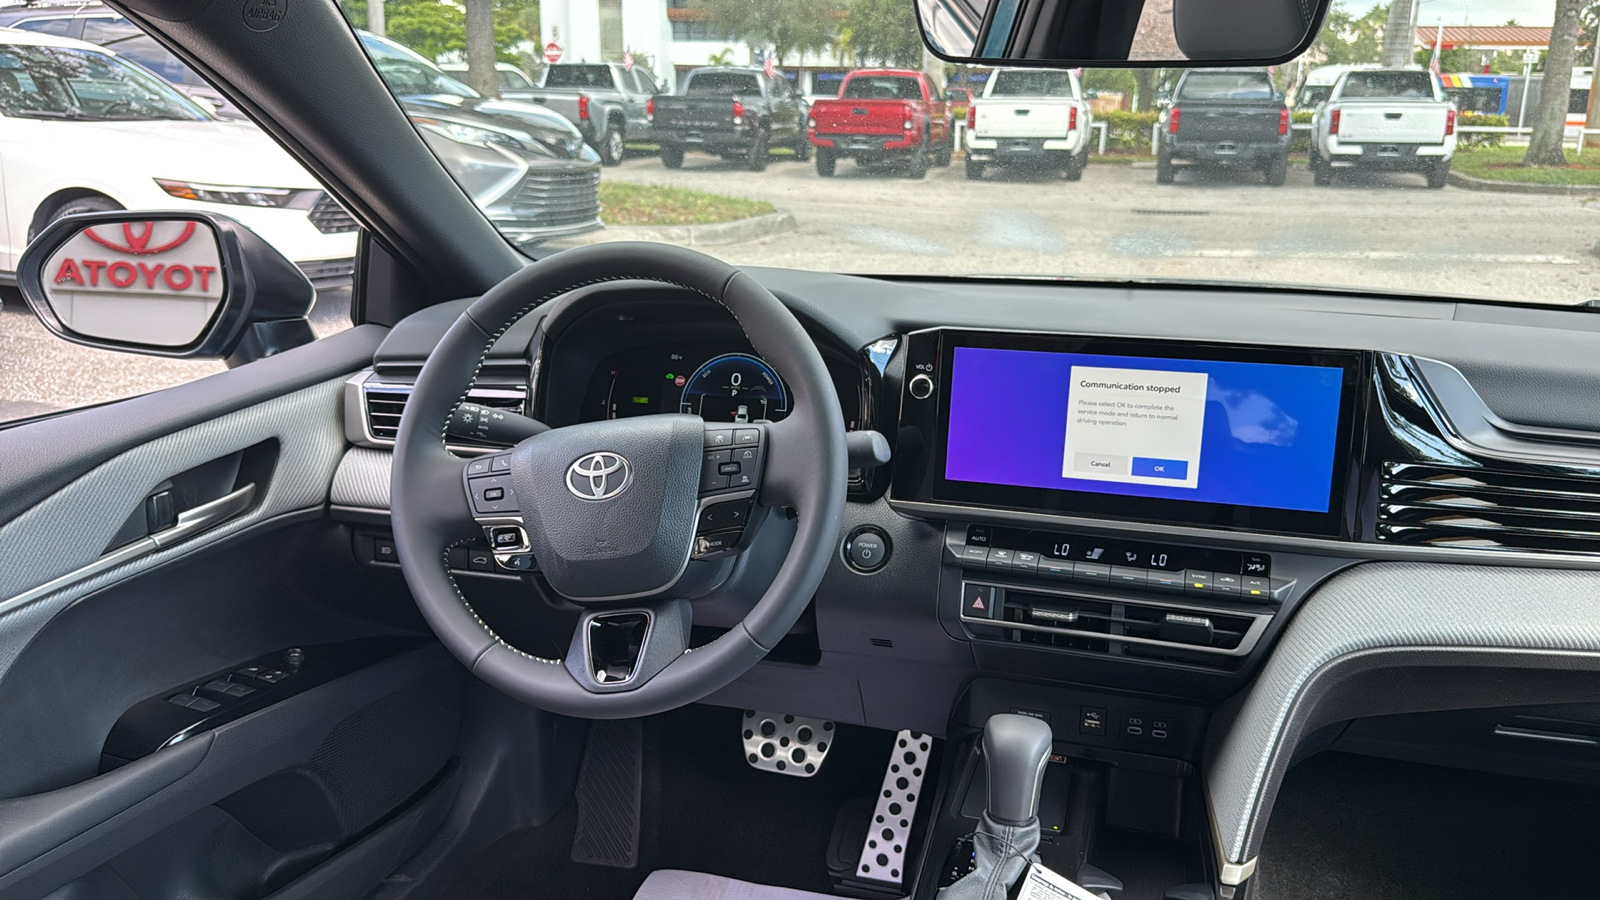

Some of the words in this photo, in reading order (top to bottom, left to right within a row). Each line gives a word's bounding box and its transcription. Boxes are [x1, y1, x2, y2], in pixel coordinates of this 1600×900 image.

[246, 7, 281, 21] AIRBAG
[702, 369, 711, 378] ECO
[731, 373, 742, 386] 0
[762, 371, 773, 385] POWER
[1080, 380, 1144, 391] Communication
[1146, 384, 1181, 393] stopped
[731, 389, 738, 397] P
[1078, 399, 1097, 407] Please
[1134, 403, 1163, 411] complete
[1076, 417, 1097, 425] driving
[1098, 419, 1127, 427] operation
[1090, 460, 1111, 468] Cancel
[858, 541, 877, 549] POWER
[1053, 543, 1070, 556] LO
[1150, 553, 1168, 567] LO
